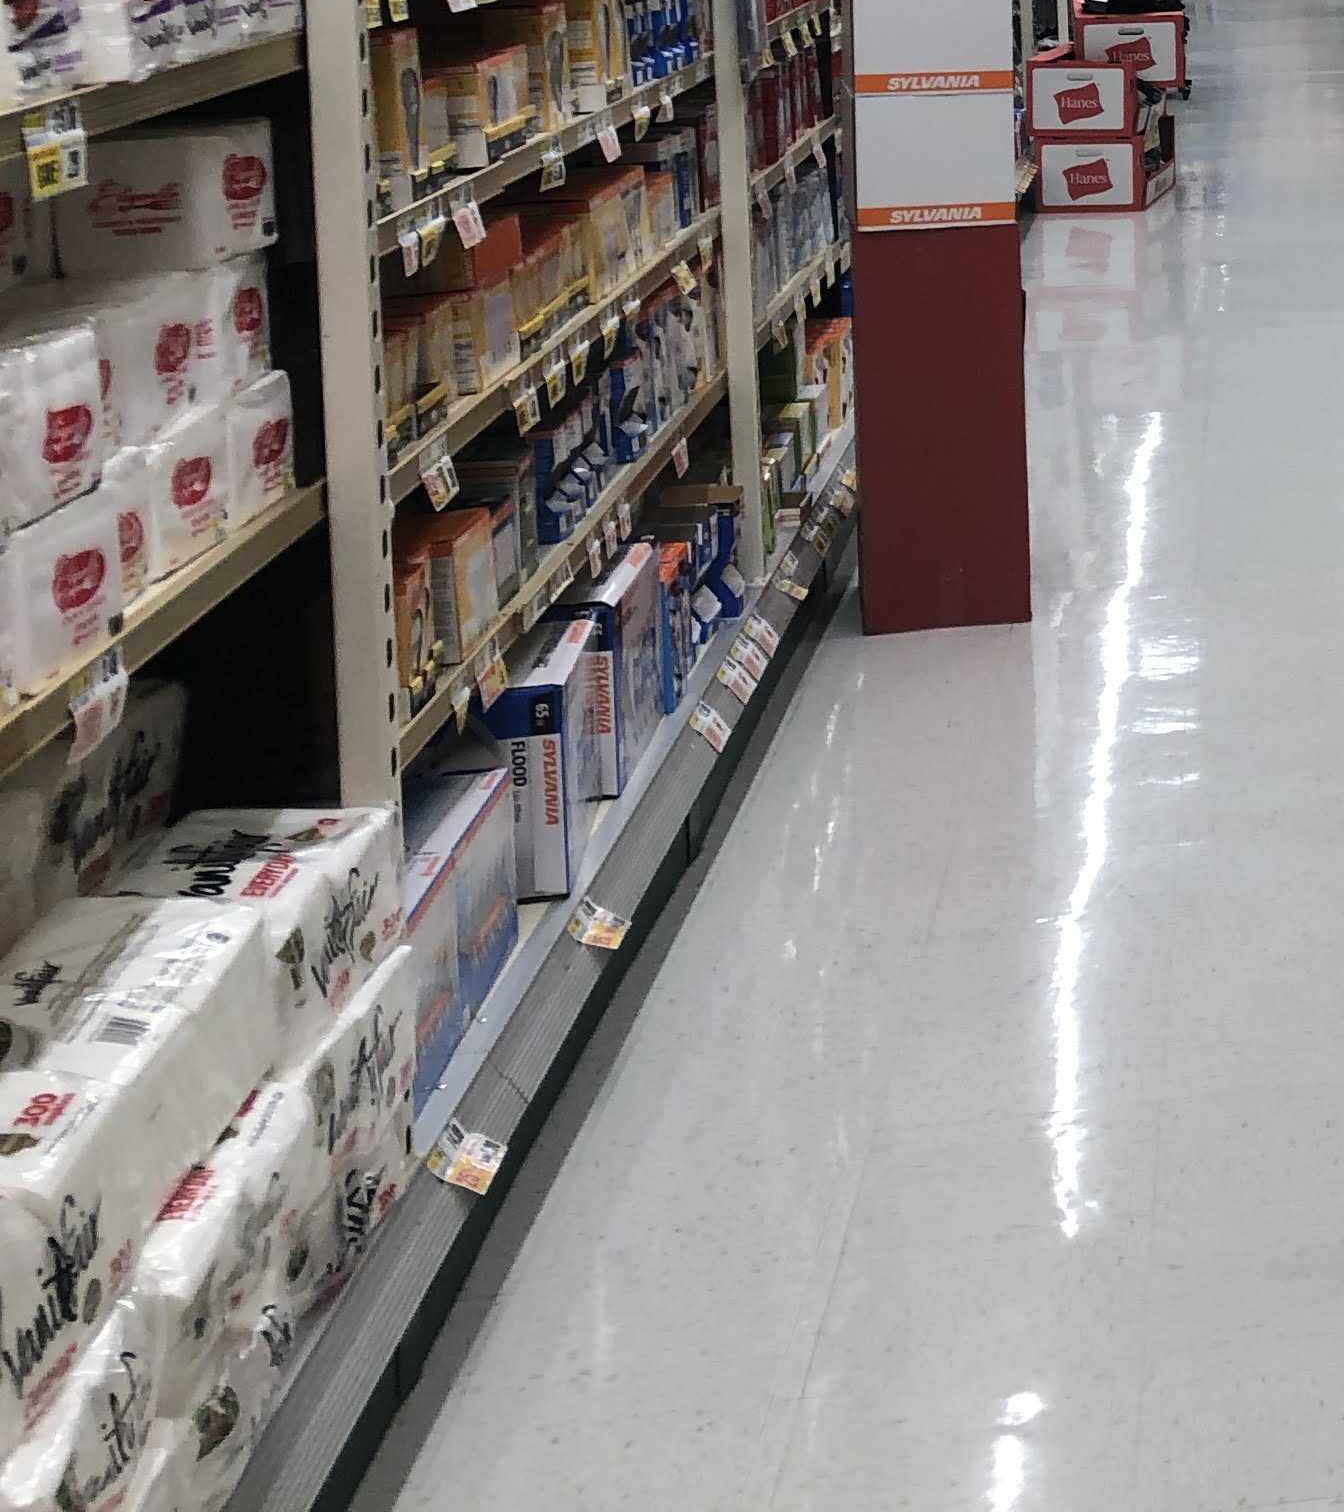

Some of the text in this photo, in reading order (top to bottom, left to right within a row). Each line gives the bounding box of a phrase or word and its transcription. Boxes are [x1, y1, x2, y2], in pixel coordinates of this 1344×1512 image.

[1112, 49, 1151, 62] Hanes
[887, 74, 980, 91] SYLVANIA
[1060, 95, 1098, 110] Hanes
[1070, 171, 1108, 185] Hanes
[890, 206, 983, 224] SYLVANIA
[511, 740, 527, 788] FLOOD
[541, 739, 560, 827] SYLVANIA
